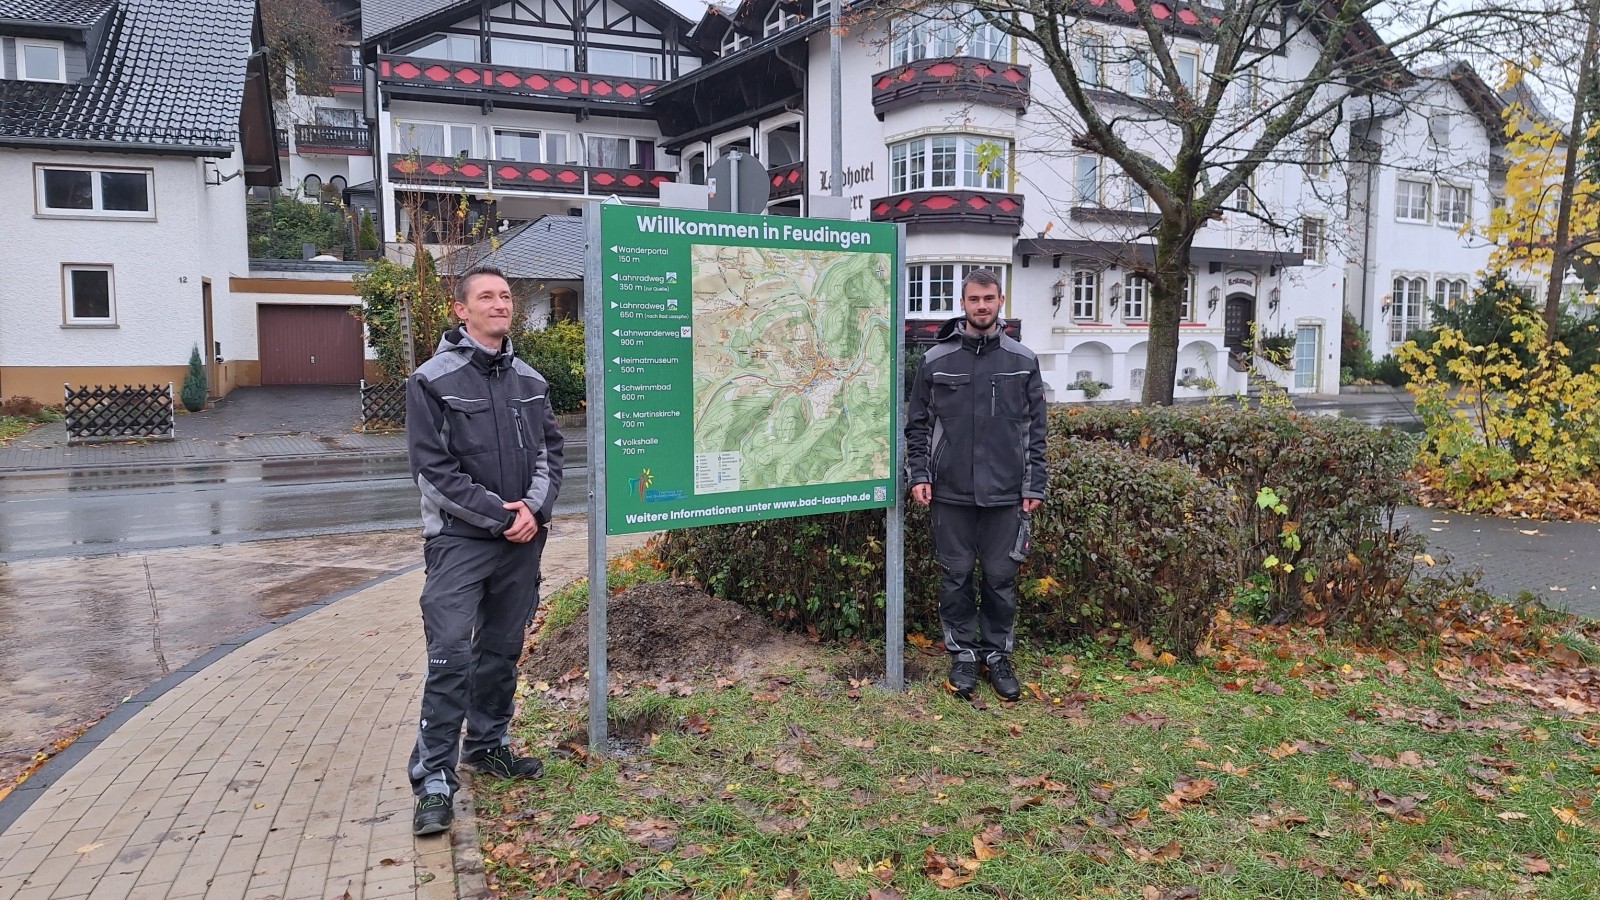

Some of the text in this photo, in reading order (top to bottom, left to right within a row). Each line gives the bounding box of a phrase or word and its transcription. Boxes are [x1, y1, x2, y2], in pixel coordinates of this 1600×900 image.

[636, 215, 871, 249] Willkommen in Feudingen
[618, 245, 669, 256] Wanderportal
[618, 255, 631, 263] 150
[178, 276, 188, 284] 12
[619, 274, 665, 284] Lahnradweg
[619, 283, 634, 291] 350
[619, 302, 665, 311] Lahnradweg
[620, 311, 634, 319] 650
[620, 329, 680, 338] Lahnwanderweg
[620, 338, 635, 346] 900
[621, 383, 672, 392] Schwimmbad
[621, 393, 636, 401] 600
[632, 409, 680, 418] Martinskirche
[622, 420, 635, 428] 700
[621, 437, 659, 446] Volkshalle
[622, 447, 636, 455] 700
[625, 492, 871, 524] Weitere Informationen unter www.bad-laasphe.de
